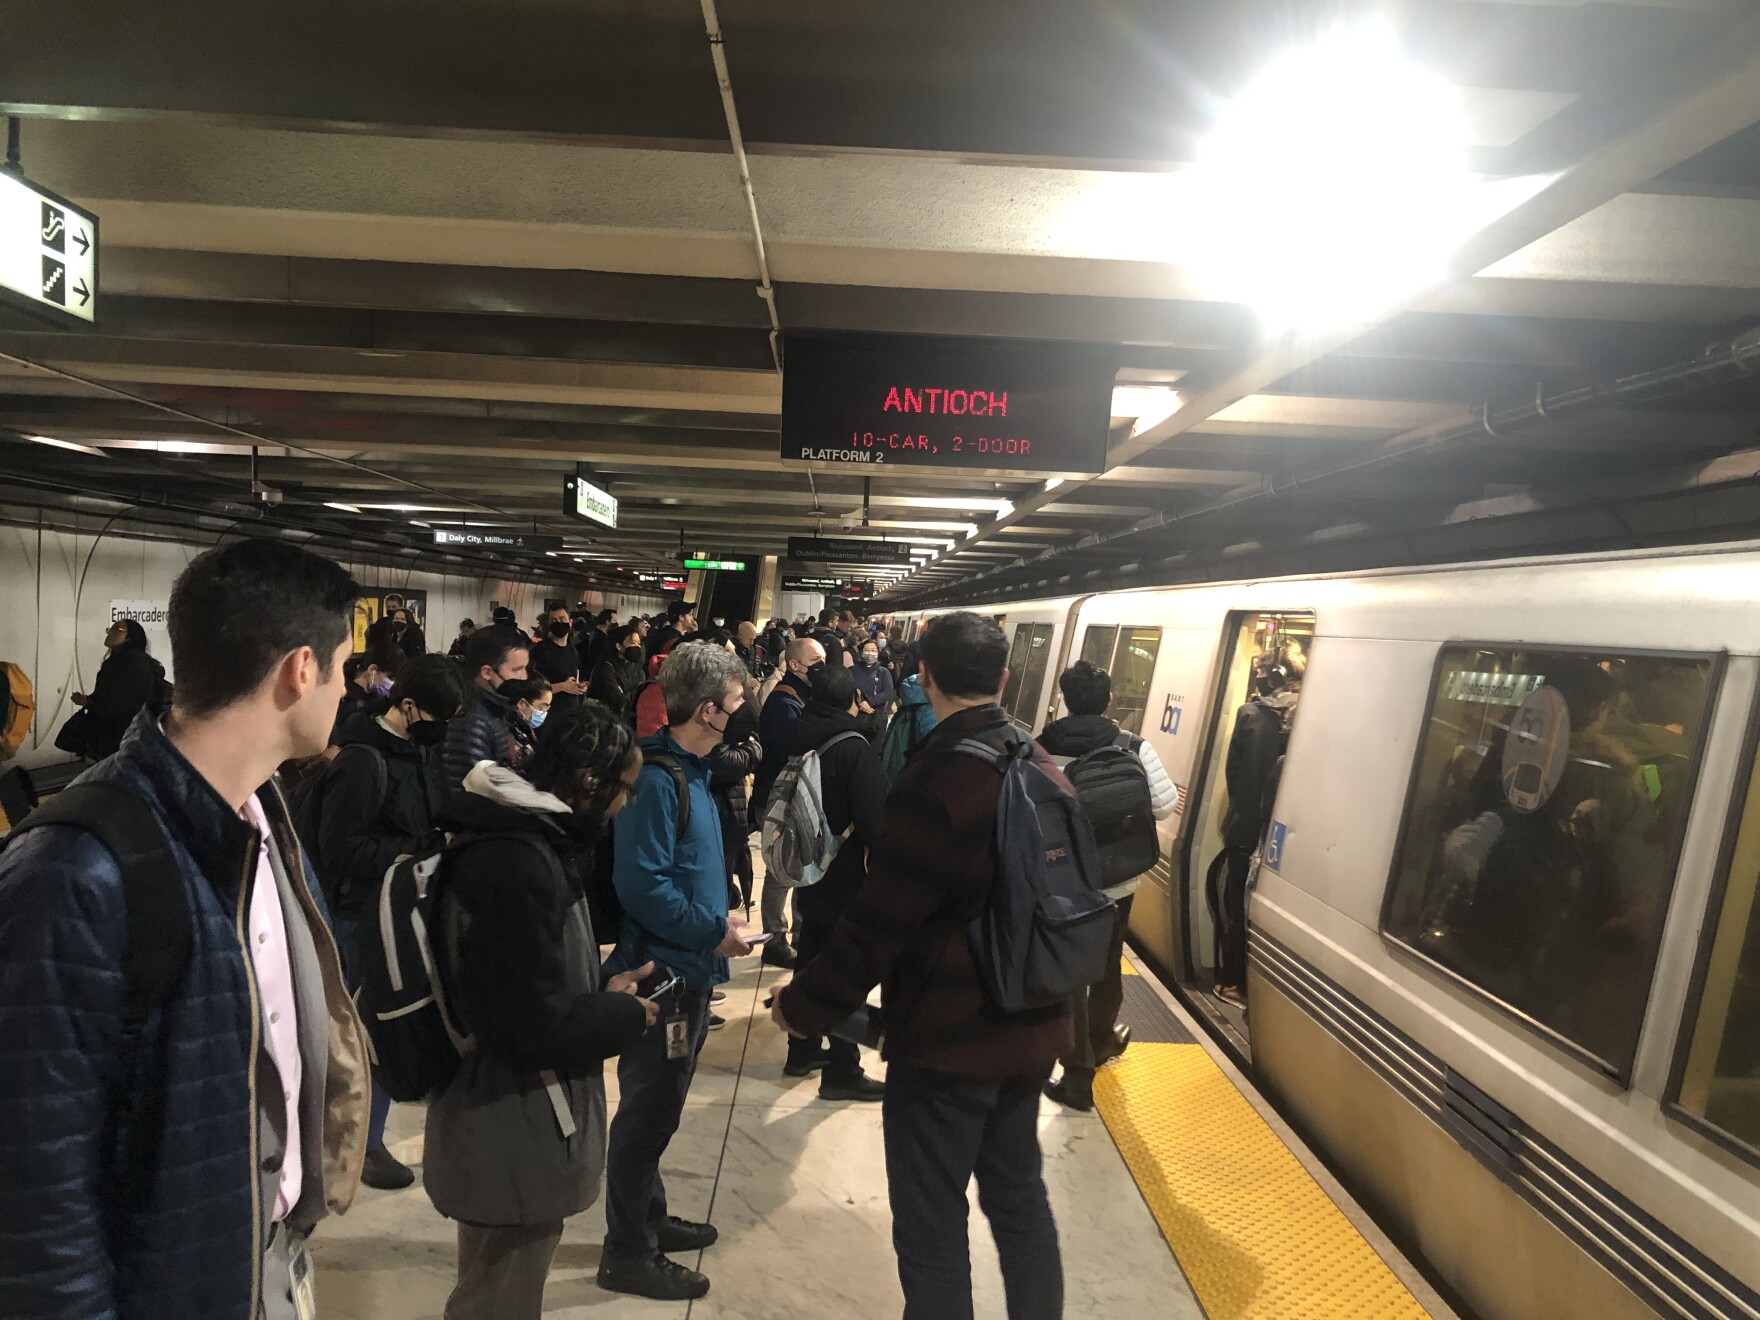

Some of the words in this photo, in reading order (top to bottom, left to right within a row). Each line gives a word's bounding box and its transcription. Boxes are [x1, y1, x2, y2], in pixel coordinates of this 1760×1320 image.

[882, 386, 1008, 417] ANTIOCH
[852, 432, 939, 454] 10-CAR,
[801, 447, 871, 463] PLATFORM
[875, 451, 884, 464] 2
[448, 534, 465, 544] Daly
[466, 535, 483, 544] City,
[484, 536, 514, 545] Millbrae
